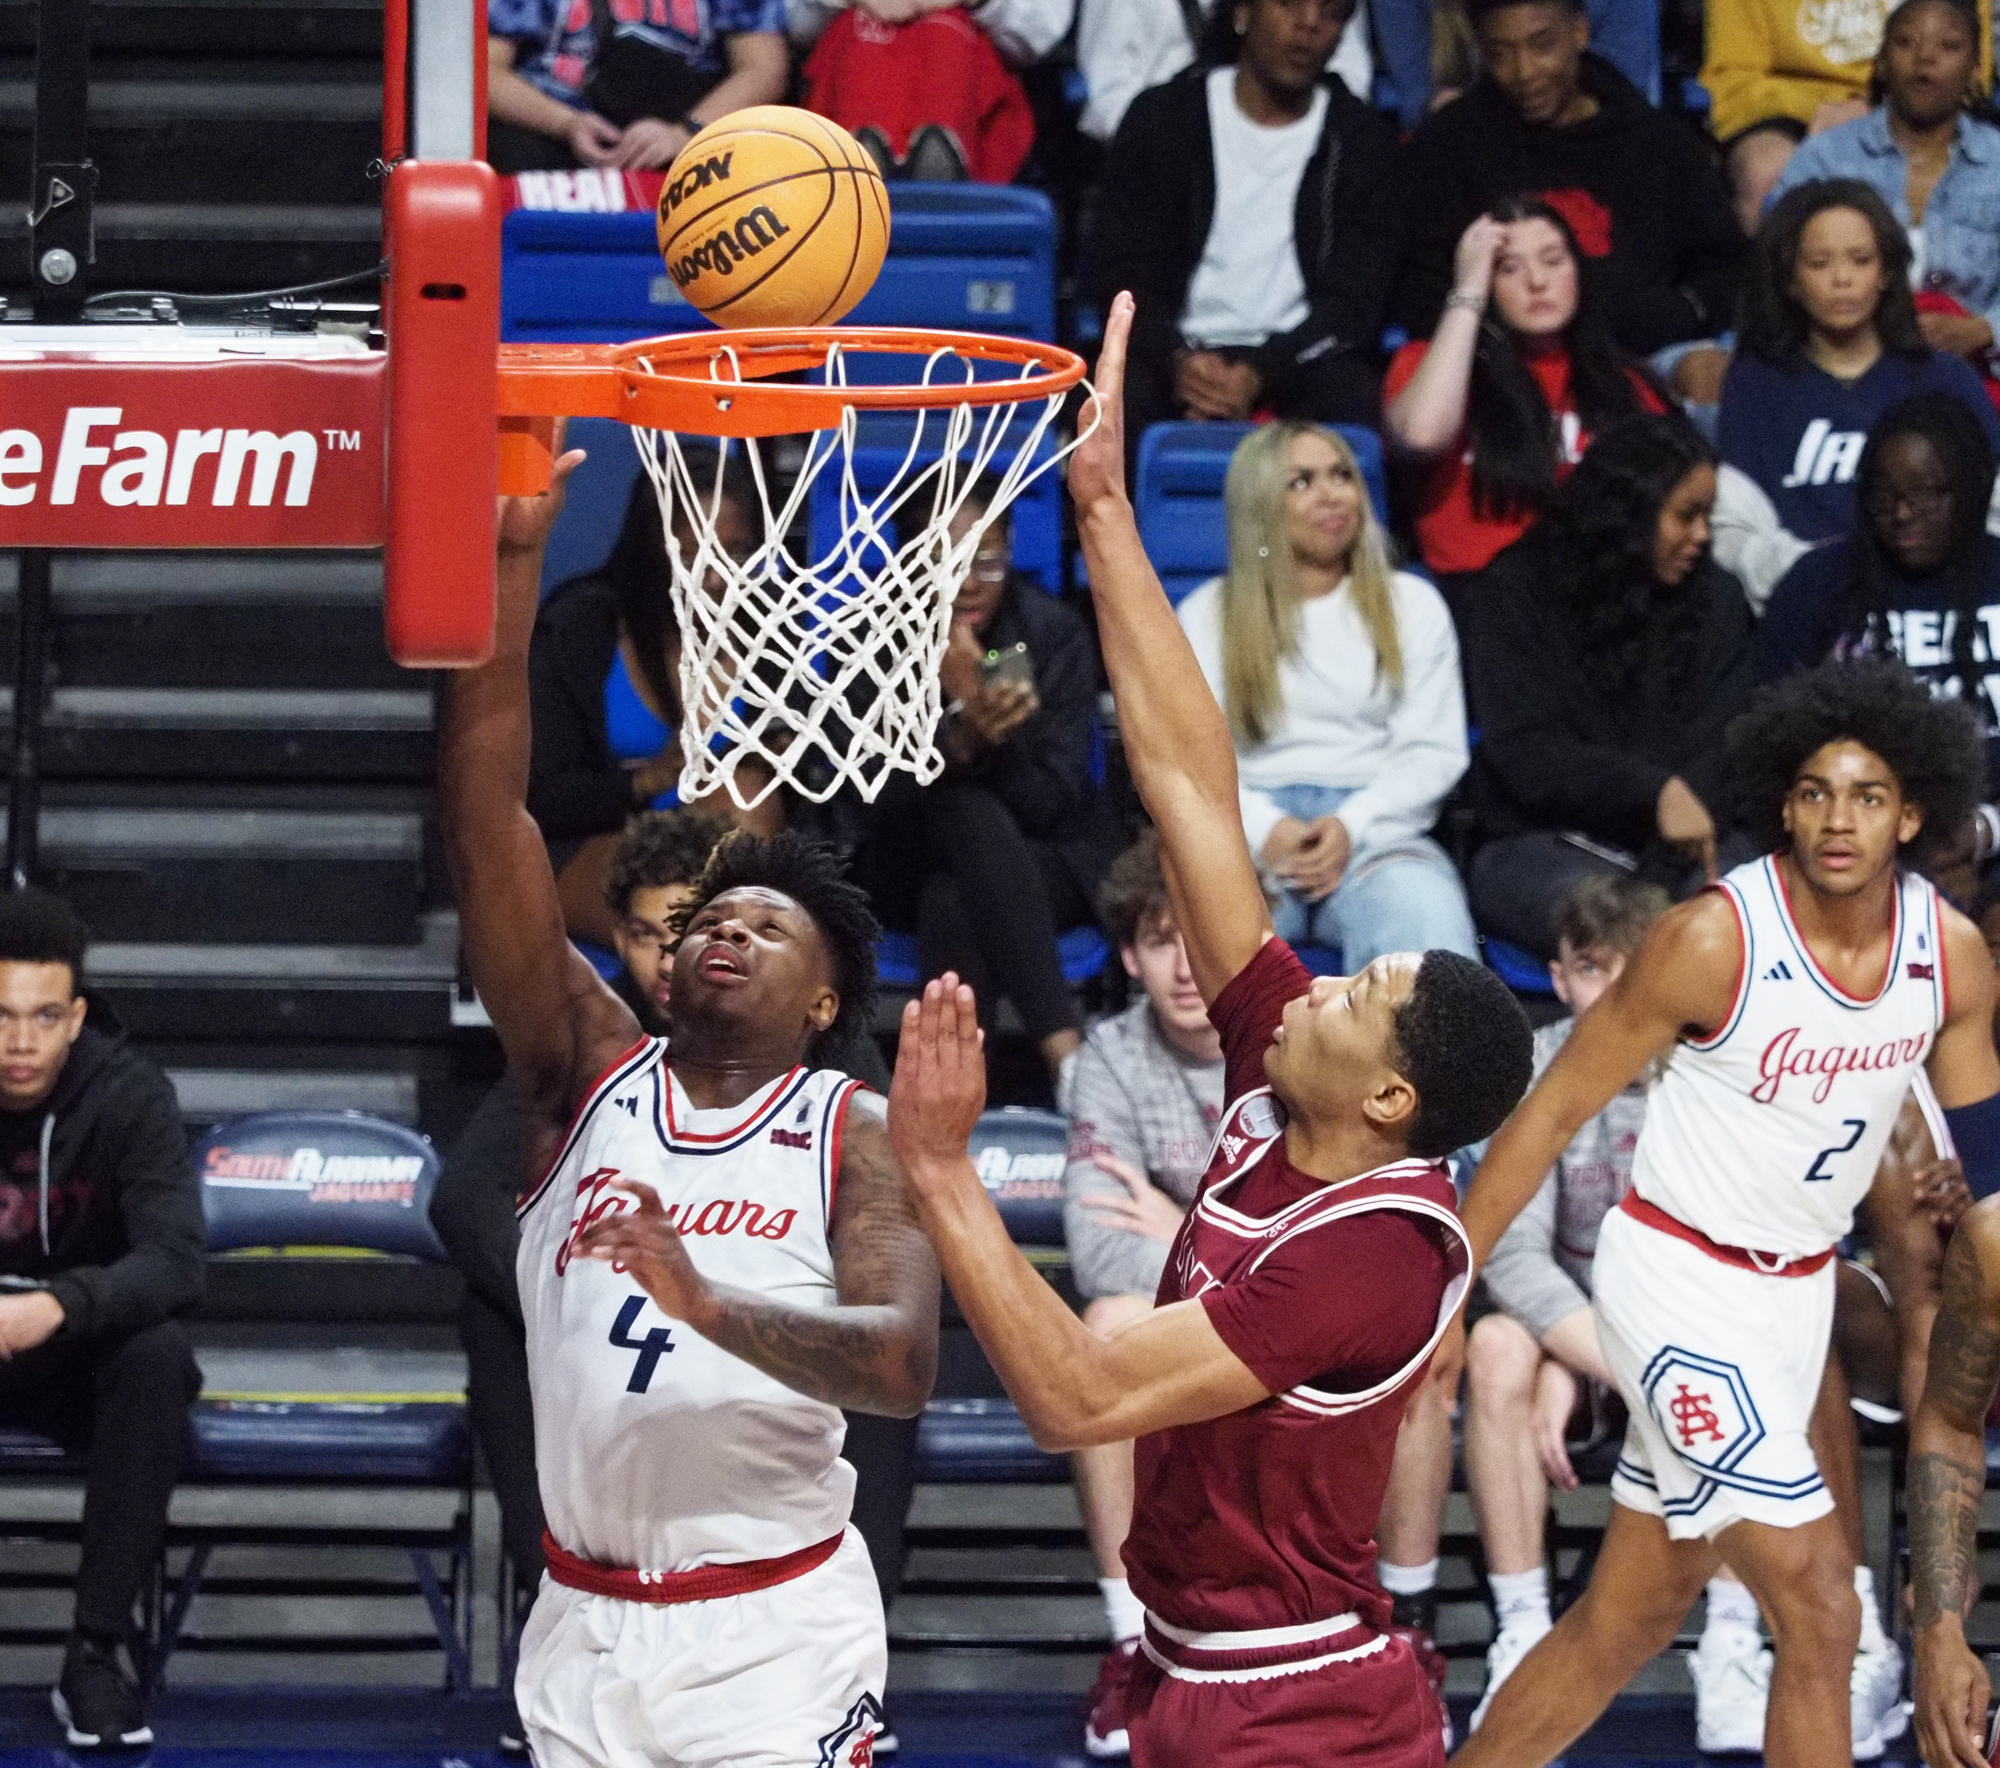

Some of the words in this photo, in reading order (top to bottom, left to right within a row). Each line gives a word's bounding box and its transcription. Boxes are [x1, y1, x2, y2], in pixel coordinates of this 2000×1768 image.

[660, 150, 734, 224] NCAA
[669, 204, 790, 288] Wilson
[1750, 1027, 1928, 1104] Jaguars
[1804, 1119, 1867, 1181] 2
[555, 1166, 799, 1277] Jauars
[608, 1295, 676, 1394] 4
